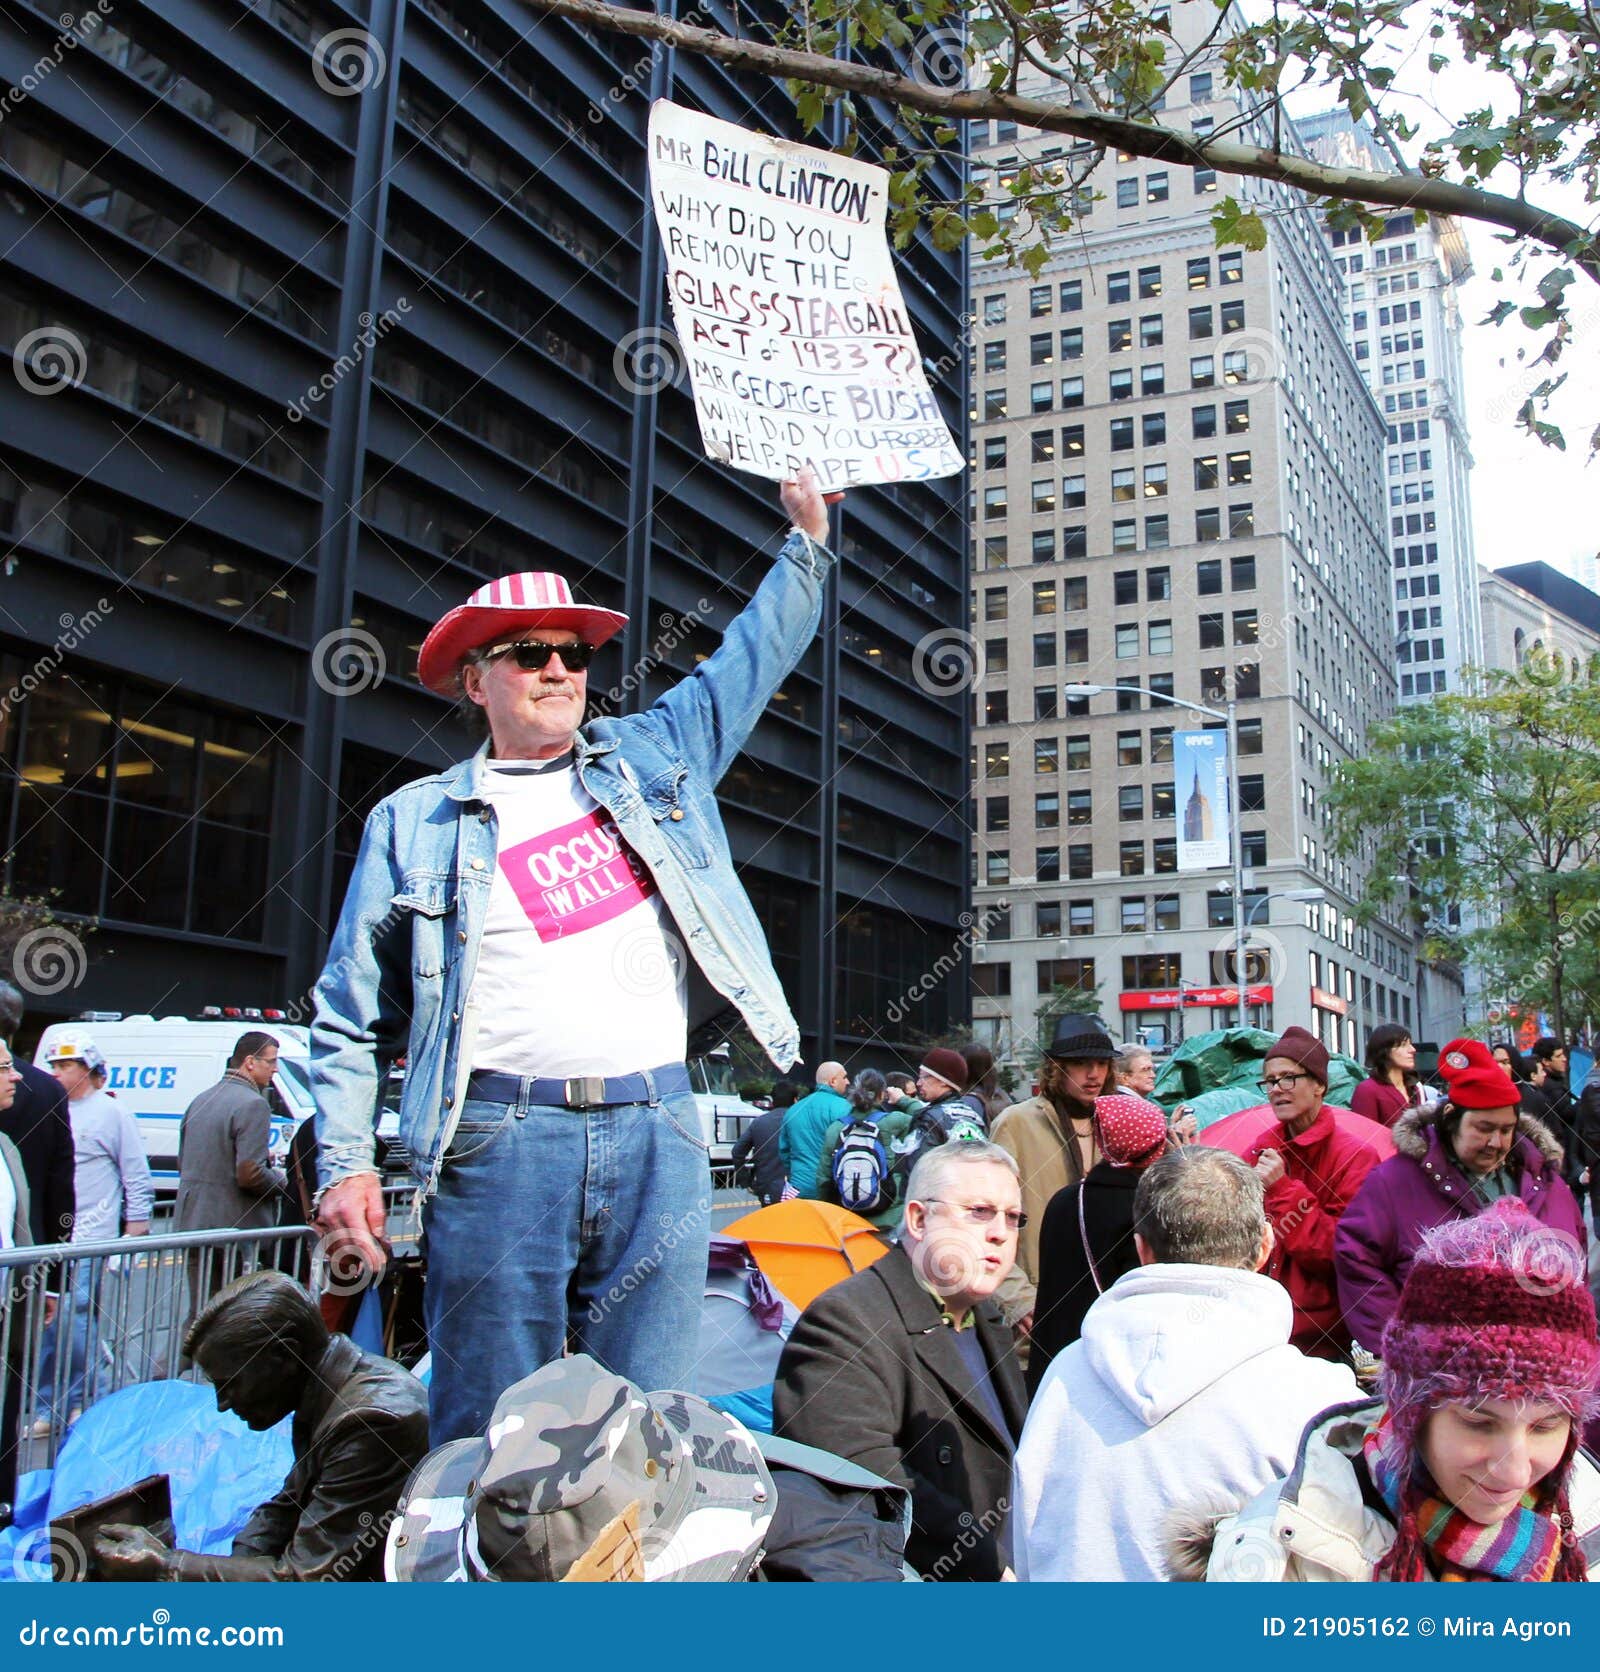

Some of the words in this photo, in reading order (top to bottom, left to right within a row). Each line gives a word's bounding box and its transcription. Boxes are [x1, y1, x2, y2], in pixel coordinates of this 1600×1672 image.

[656, 134, 693, 166] MR
[660, 190, 722, 228] WHY
[786, 221, 851, 262] YOU
[669, 227, 778, 283] REMOVE
[693, 317, 751, 356] ACT
[792, 340, 868, 371] 1933
[693, 358, 729, 390] MR
[732, 369, 838, 417] GEORGE
[844, 384, 938, 422] BUSH
[699, 396, 752, 434] WHY
[527, 822, 621, 888] OCCUP
[546, 866, 625, 916] WALL
[626, 851, 643, 877] S
[108, 1066, 177, 1089] LICE
